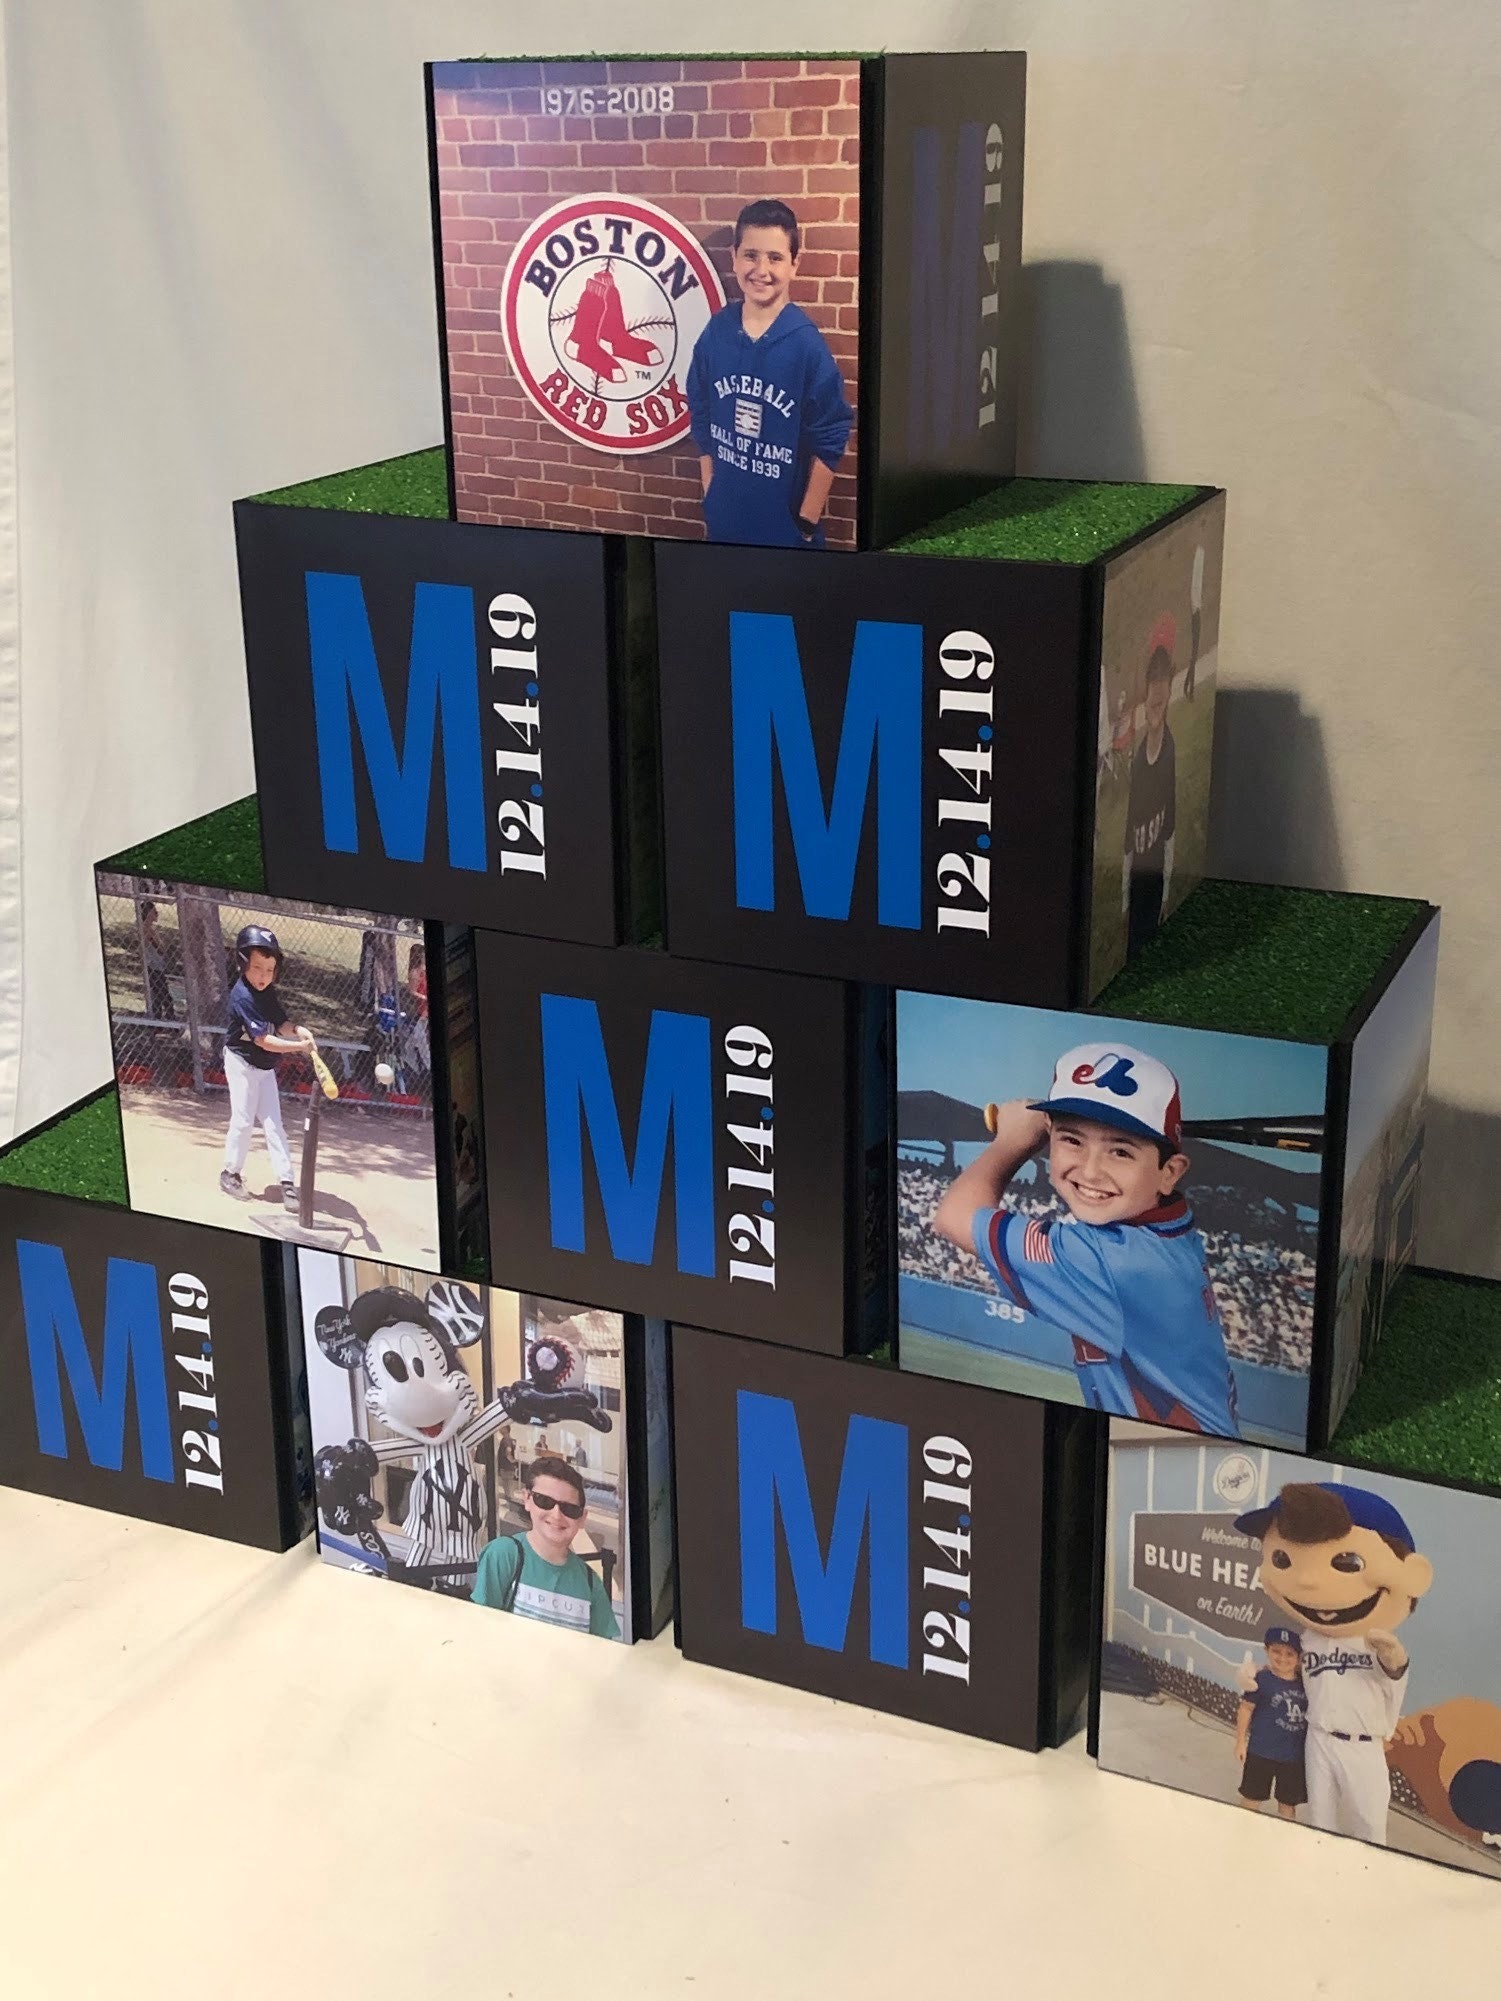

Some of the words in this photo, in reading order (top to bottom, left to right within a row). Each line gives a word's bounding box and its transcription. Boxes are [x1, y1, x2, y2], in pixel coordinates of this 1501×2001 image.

[540, 86, 674, 115] 1976-2008
[524, 218, 699, 300] BOSTON
[540, 368, 608, 431] RED
[626, 373, 689, 435] SOX
[635, 370, 652, 381] TM
[713, 375, 796, 418] BASEBALL
[710, 423, 734, 447] HALL
[736, 436, 752, 453] OF
[755, 442, 793, 464] FAME
[717, 444, 748, 471] SINCE
[751, 459, 781, 479] 1939
[304, 571, 488, 872] M
[488, 593, 547, 880] 12.14.19
[729, 611, 924, 930] M
[937, 630, 995, 939] 12.14.19
[540, 993, 716, 1278] M
[724, 1025, 776, 1291] 12.14.19
[984, 1301, 1025, 1323] 385
[16, 1239, 175, 1483] M
[168, 1272, 224, 1496] 12.14.19
[737, 1389, 909, 1669] M
[923, 1435, 973, 1686] 12.14.19
[1144, 1543, 1203, 1578] BLUE
[1201, 1526, 1249, 1550] Welcome
[1197, 1597, 1214, 1613] on
[1215, 1597, 1264, 1626] Earth!
[1301, 1647, 1374, 1677] Dodgers
